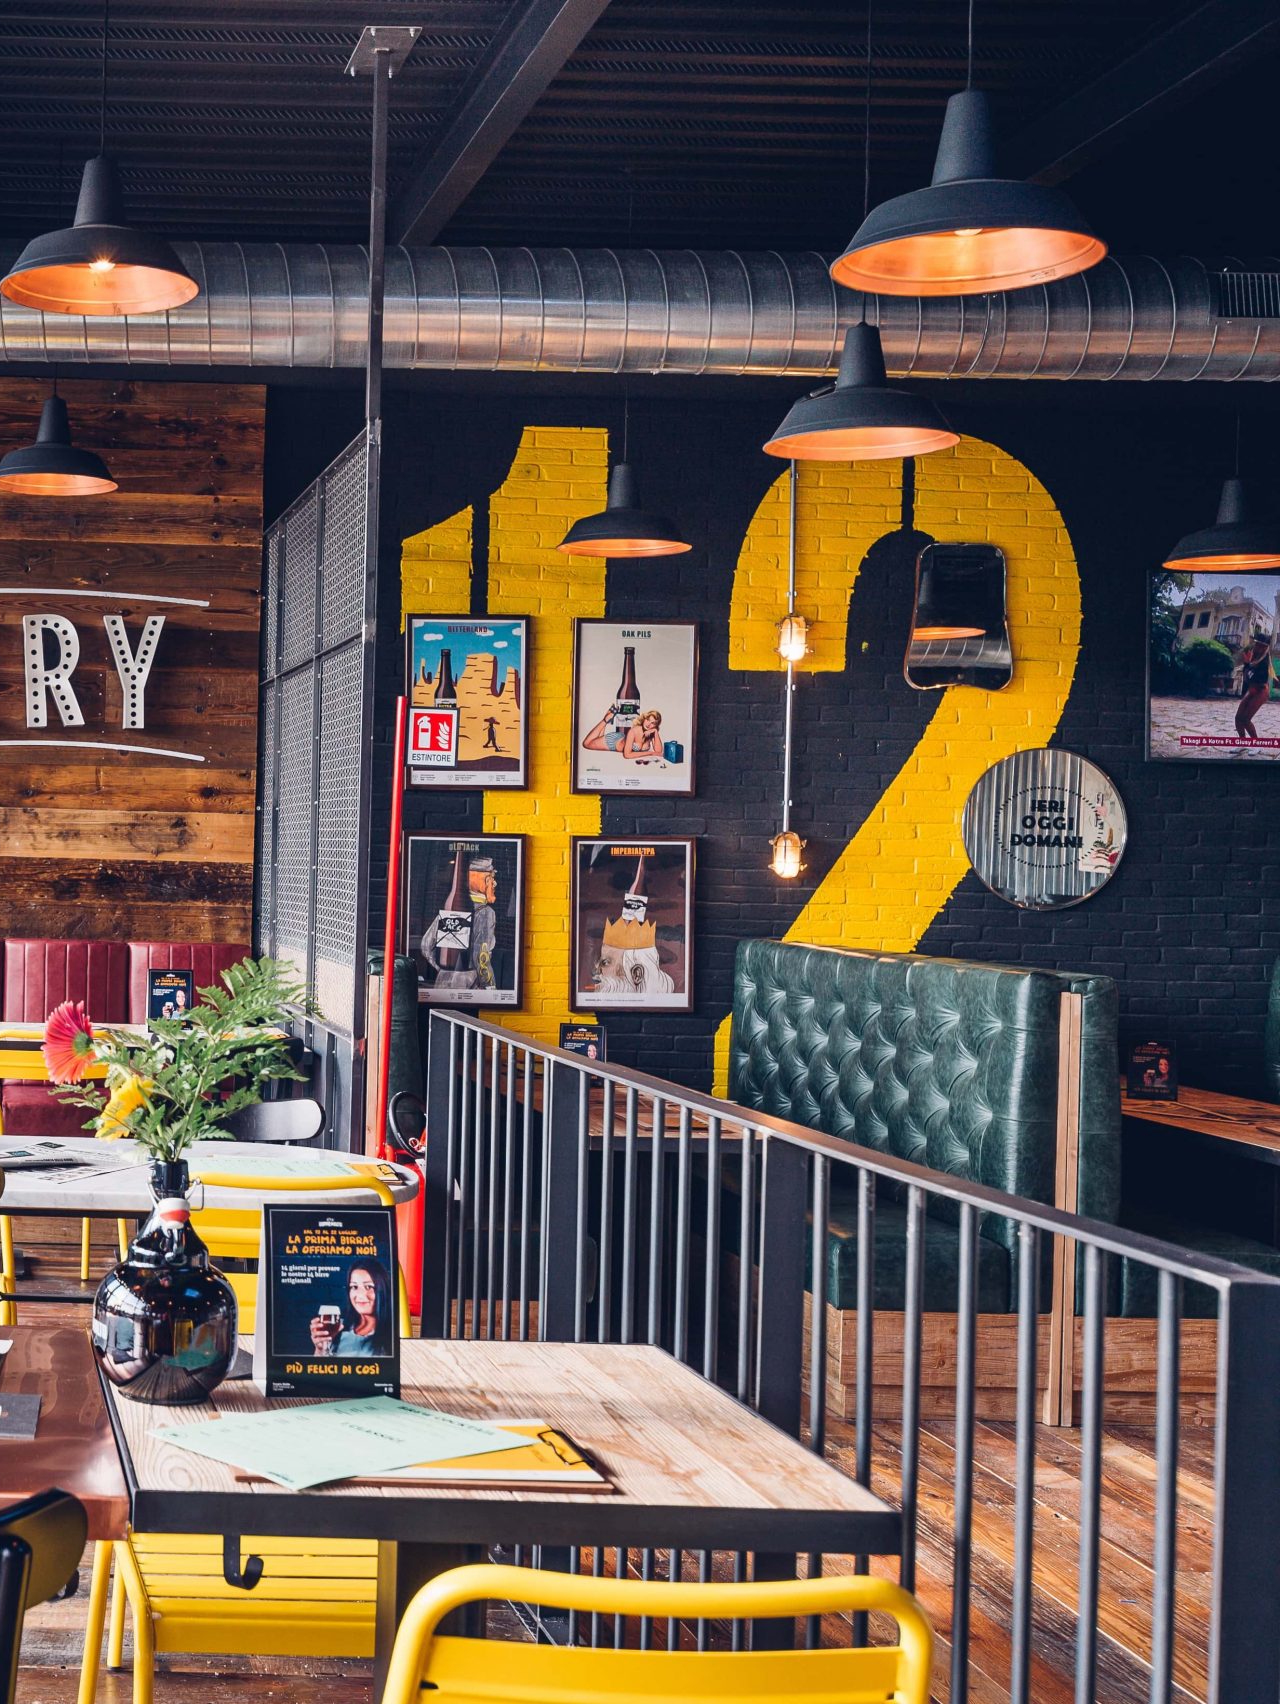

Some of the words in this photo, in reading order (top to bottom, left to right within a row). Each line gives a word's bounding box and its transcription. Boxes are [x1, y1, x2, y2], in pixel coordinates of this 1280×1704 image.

[622, 630, 636, 638] OAK
[637, 630, 652, 638] PILS
[412, 753, 452, 762] ESTINTORE
[1031, 799, 1065, 813] IERI
[1022, 815, 1074, 831] OGGI
[1011, 833, 1083, 848] DOMANI
[611, 847, 642, 855] IMPERIAL
[288, 1235, 301, 1244] LA
[304, 1235, 337, 1244] PRIMA
[340, 1235, 374, 1246] BIRRA?
[285, 1245, 299, 1254] LA
[302, 1245, 352, 1255] OFFRIAMO
[356, 1245, 377, 1256] NOI!
[289, 1264, 307, 1272] giorni
[286, 1361, 303, 1374] PIÙ
[307, 1364, 338, 1375] FELICI
[342, 1364, 352, 1375] DI
[355, 1362, 380, 1375] COSÌ
